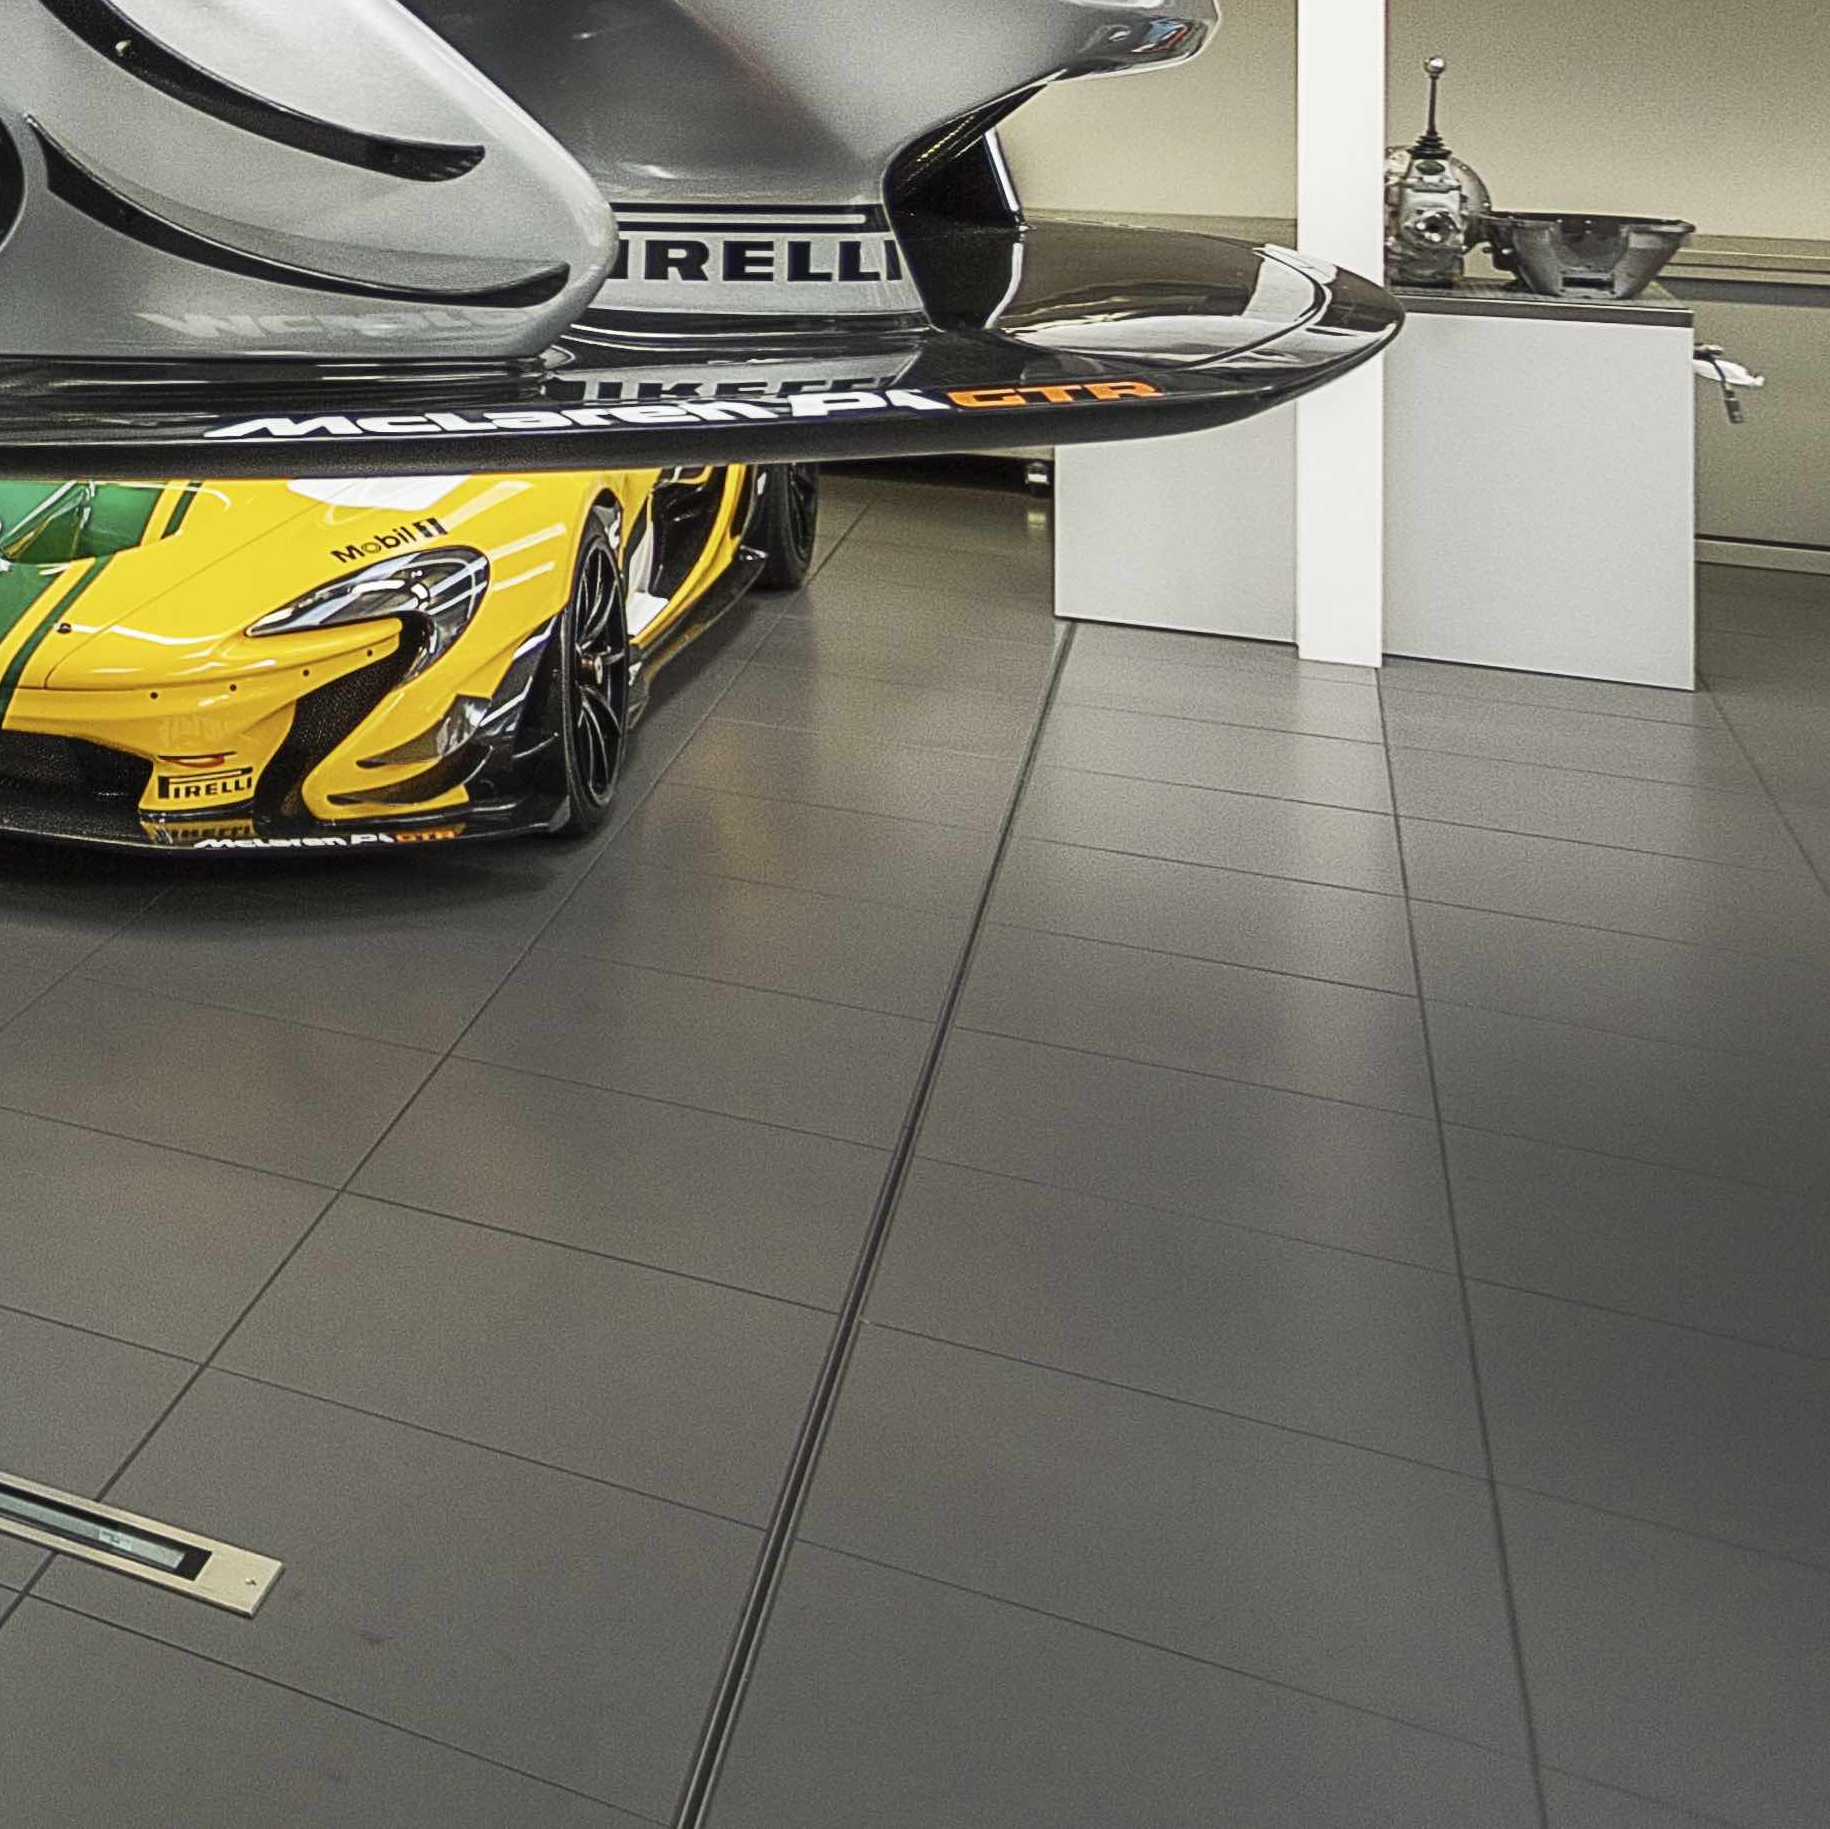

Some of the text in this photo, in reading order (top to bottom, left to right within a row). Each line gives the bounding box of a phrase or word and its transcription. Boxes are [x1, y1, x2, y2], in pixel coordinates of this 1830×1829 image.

[606, 222, 905, 283] IRELLI
[204, 396, 779, 438] McLaren
[947, 381, 1166, 409] GTR
[330, 525, 418, 563] Mobil
[157, 767, 253, 800] PIRELLI
[194, 837, 347, 849] McLaren
